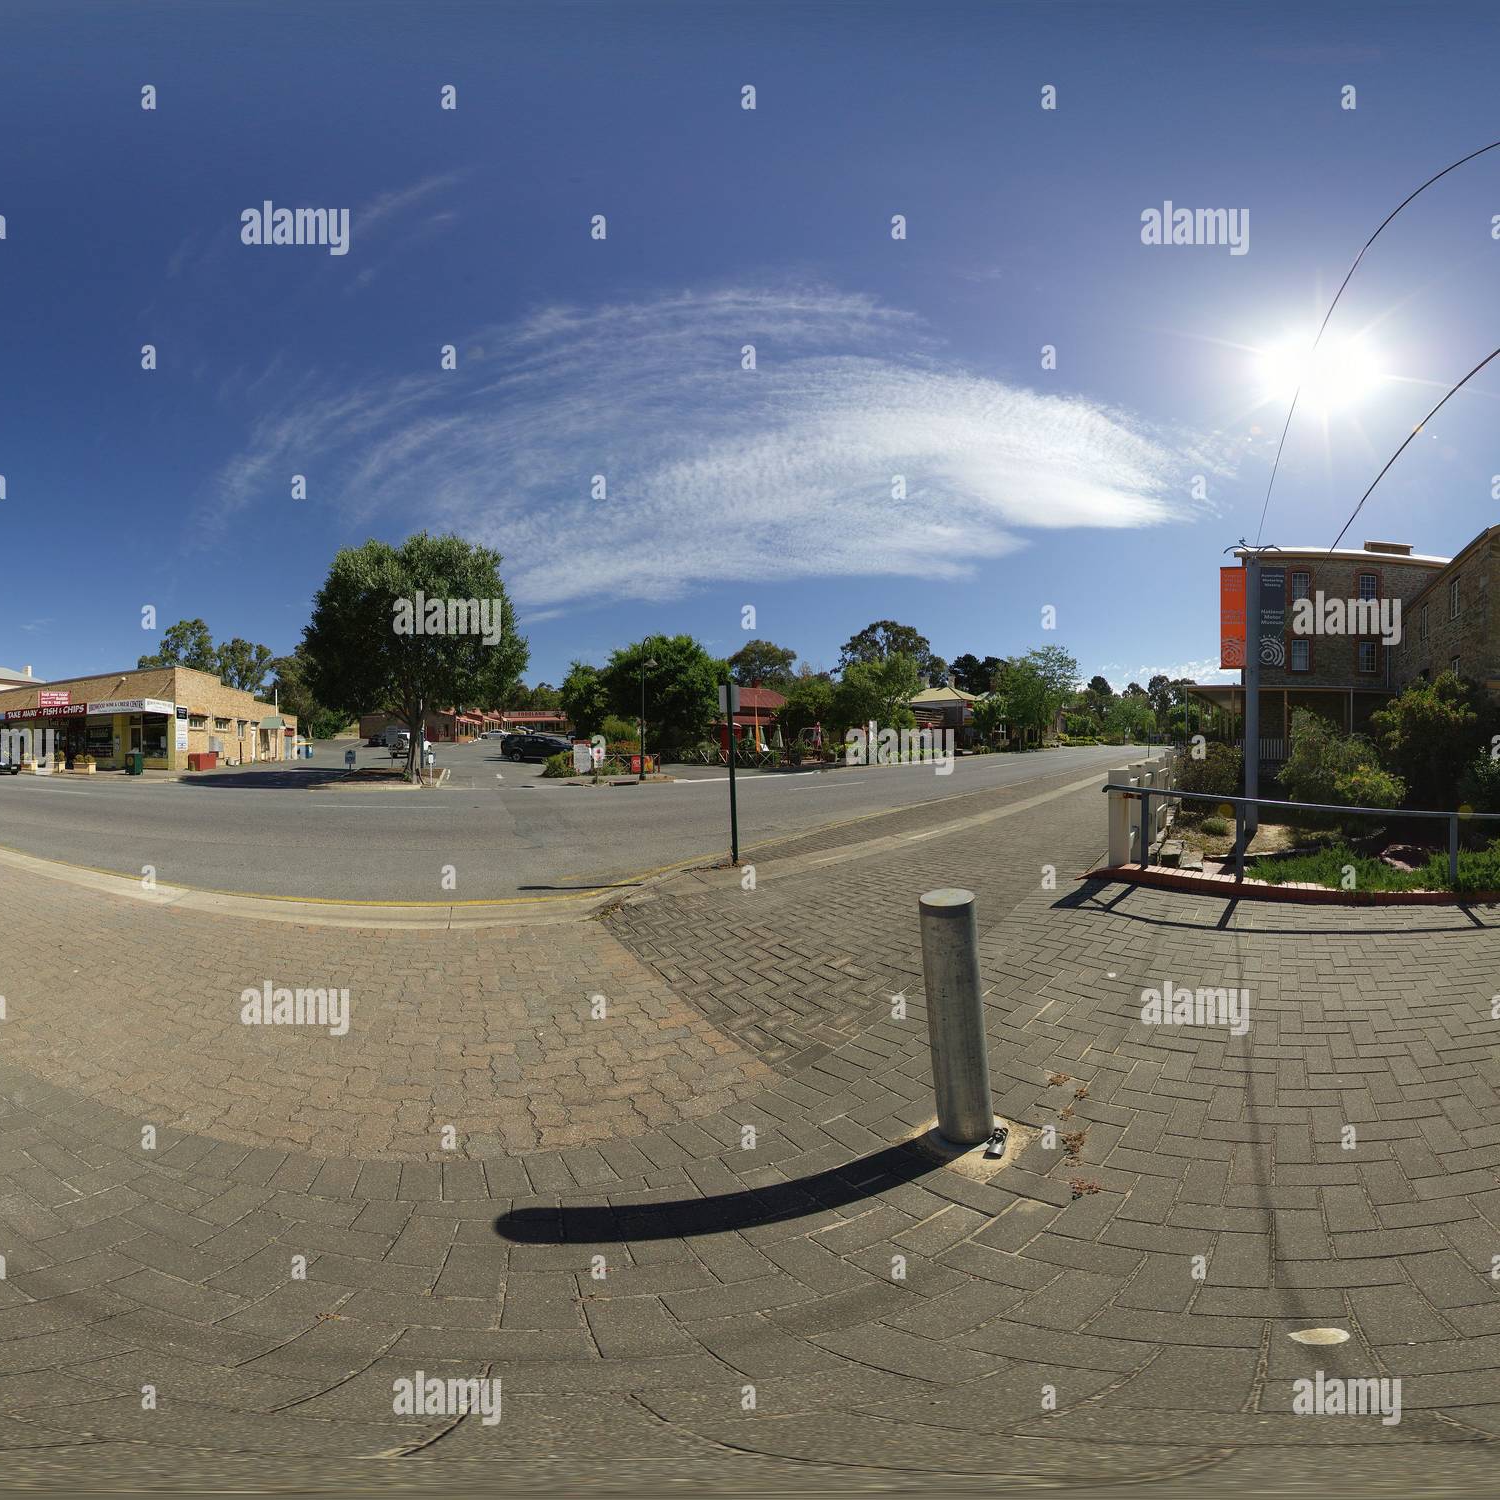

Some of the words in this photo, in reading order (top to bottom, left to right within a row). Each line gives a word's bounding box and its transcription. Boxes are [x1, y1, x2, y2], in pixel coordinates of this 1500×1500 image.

[7, 711, 21, 719] TAKE
[22, 709, 37, 717] AWAY
[43, 707, 58, 716] FISH
[63, 704, 84, 714] CHIPS
